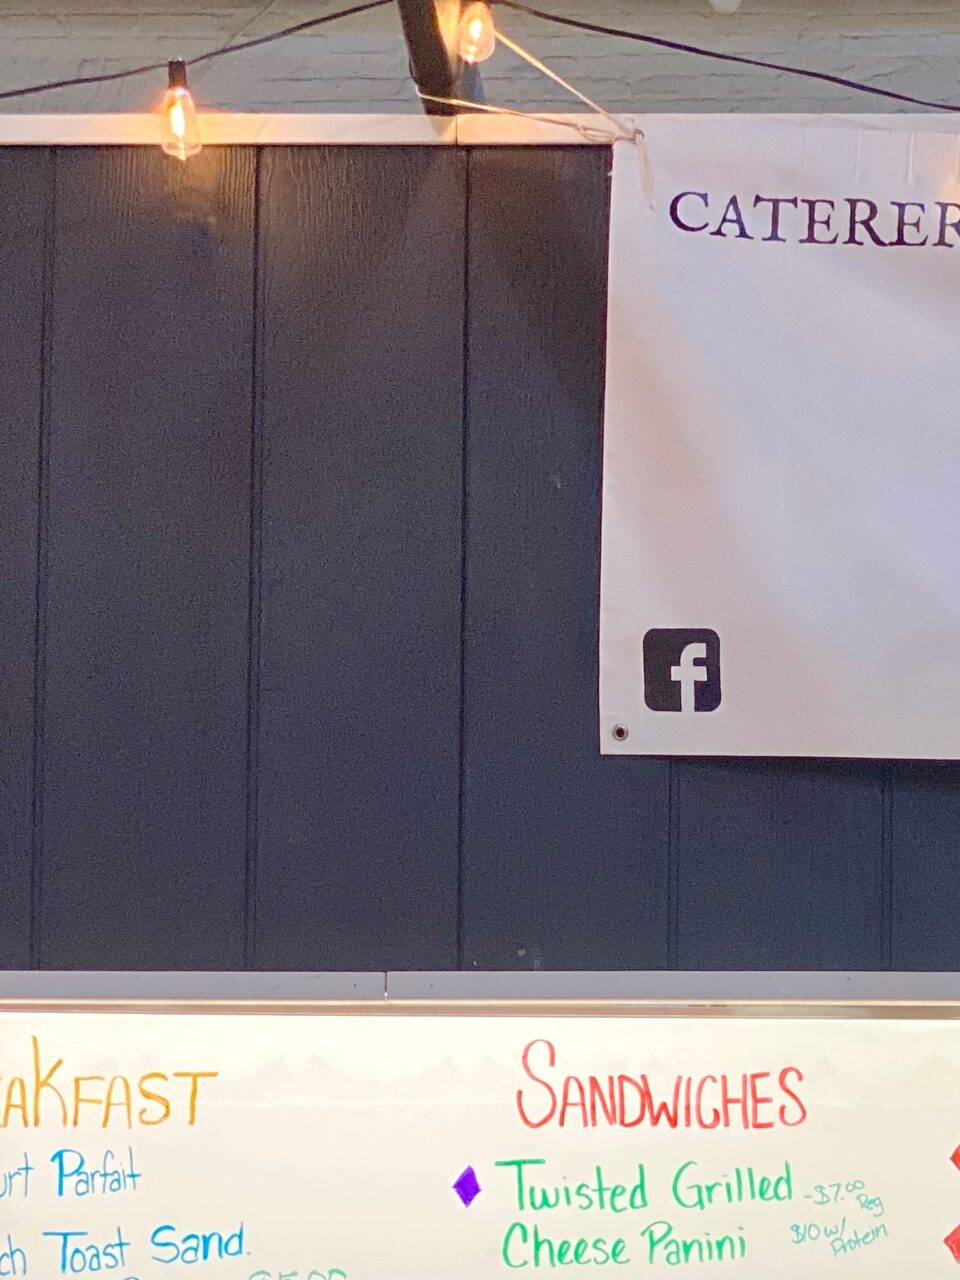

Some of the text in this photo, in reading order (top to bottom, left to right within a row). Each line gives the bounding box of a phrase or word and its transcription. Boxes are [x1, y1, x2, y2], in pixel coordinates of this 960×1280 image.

[0, 1036, 218, 1129] AKFAST
[516, 1039, 808, 1129] SANDWICHES
[495, 1158, 648, 1213] Twisted
[671, 1161, 794, 1209] Grilled
[42, 1226, 131, 1274] Toast
[501, 1220, 748, 1268] Cheese Panini
